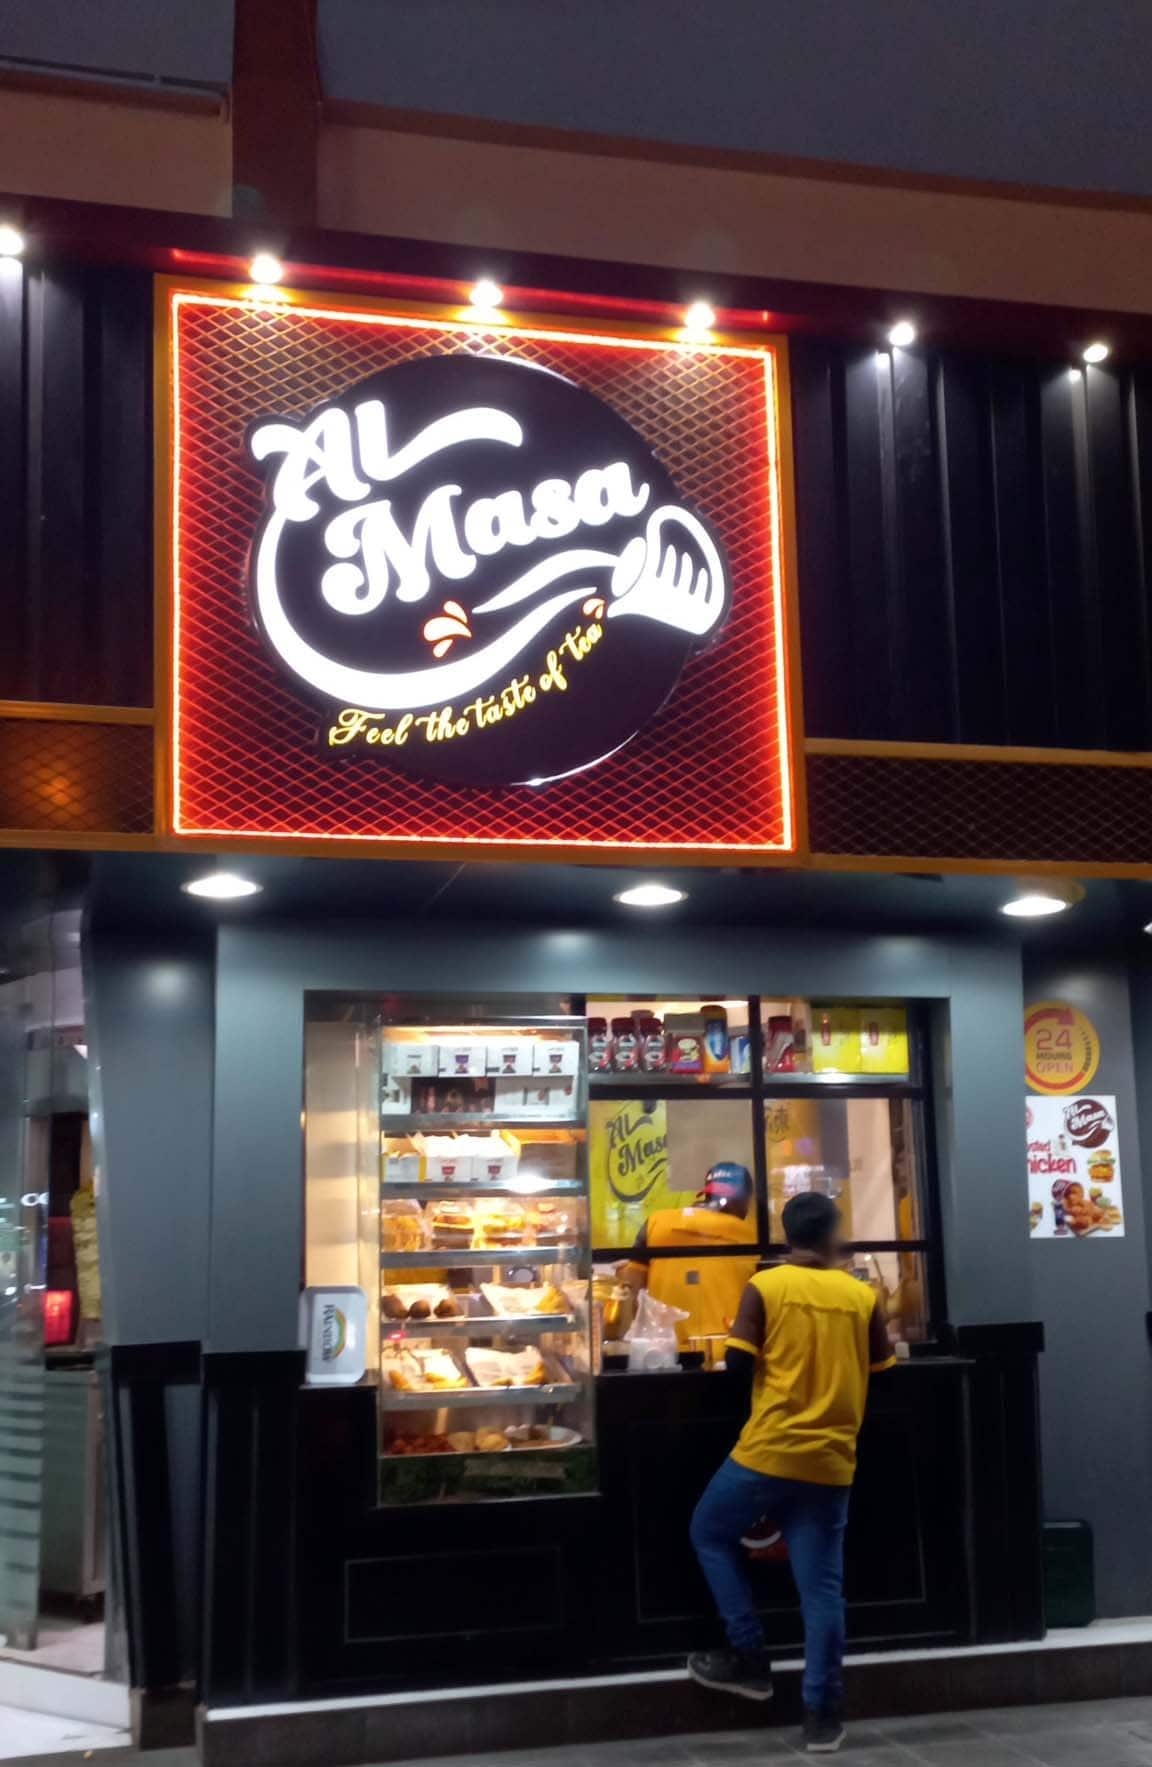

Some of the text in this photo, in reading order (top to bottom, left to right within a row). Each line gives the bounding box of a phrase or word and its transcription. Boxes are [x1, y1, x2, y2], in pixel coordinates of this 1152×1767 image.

[251, 400, 523, 522] Al
[321, 461, 649, 616] Masa
[328, 622, 604, 746] Feel the taste of tea
[1036, 1028, 1073, 1050] 24
[1036, 1062, 1073, 1073] OPEN
[606, 1113, 653, 1148] Al
